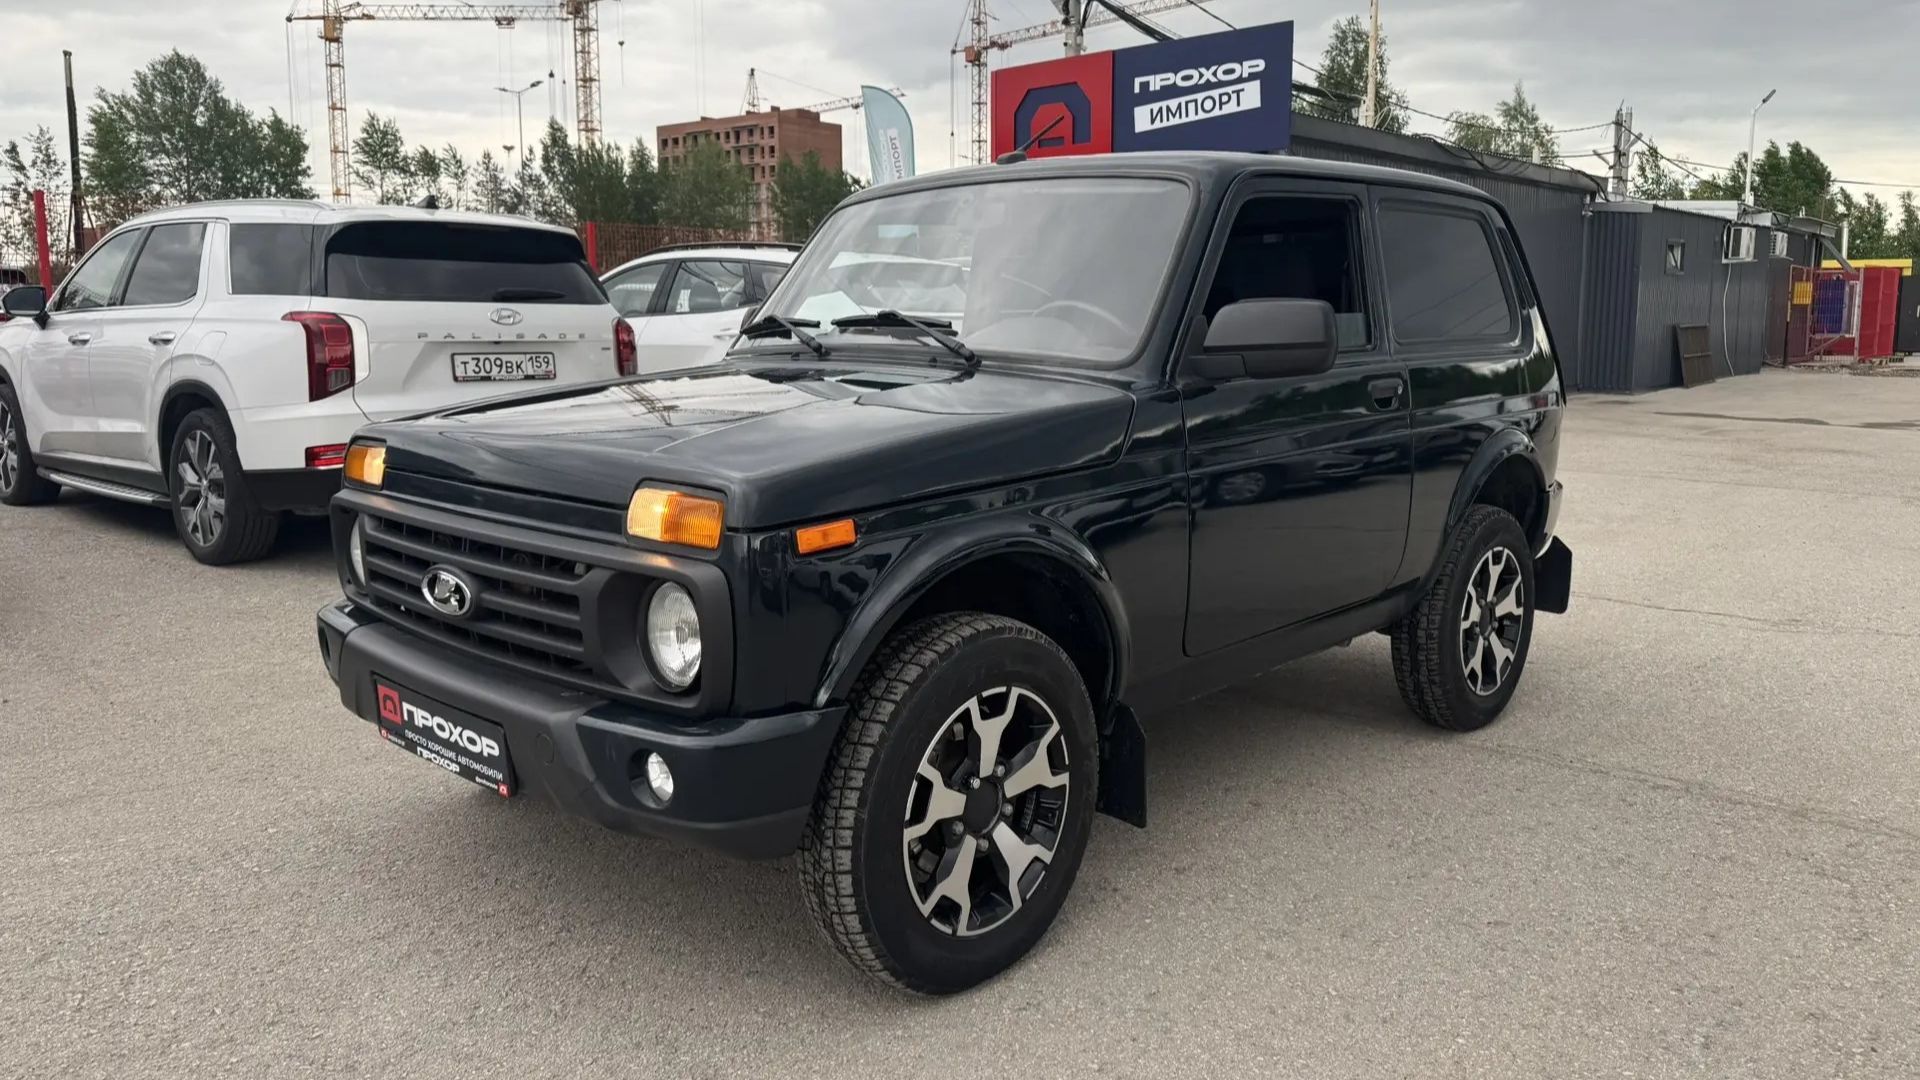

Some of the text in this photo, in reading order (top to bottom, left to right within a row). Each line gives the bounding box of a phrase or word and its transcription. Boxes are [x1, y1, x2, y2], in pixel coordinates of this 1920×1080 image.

[1134, 58, 1266, 94] ПРОХОР
[1150, 88, 1245, 126] ИМПОРТ
[889, 135, 903, 180] МПОРТ
[417, 332, 586, 340] PALISADE
[460, 355, 550, 375] Т309ВК 159
[401, 701, 500, 757] ПРОХОР
[404, 729, 427, 746] ПРОСТО
[428, 740, 457, 761] ХОРОШИЕ
[458, 754, 503, 782] АВТОМОБИЛИ
[416, 746, 460, 773] ПРОХОР
